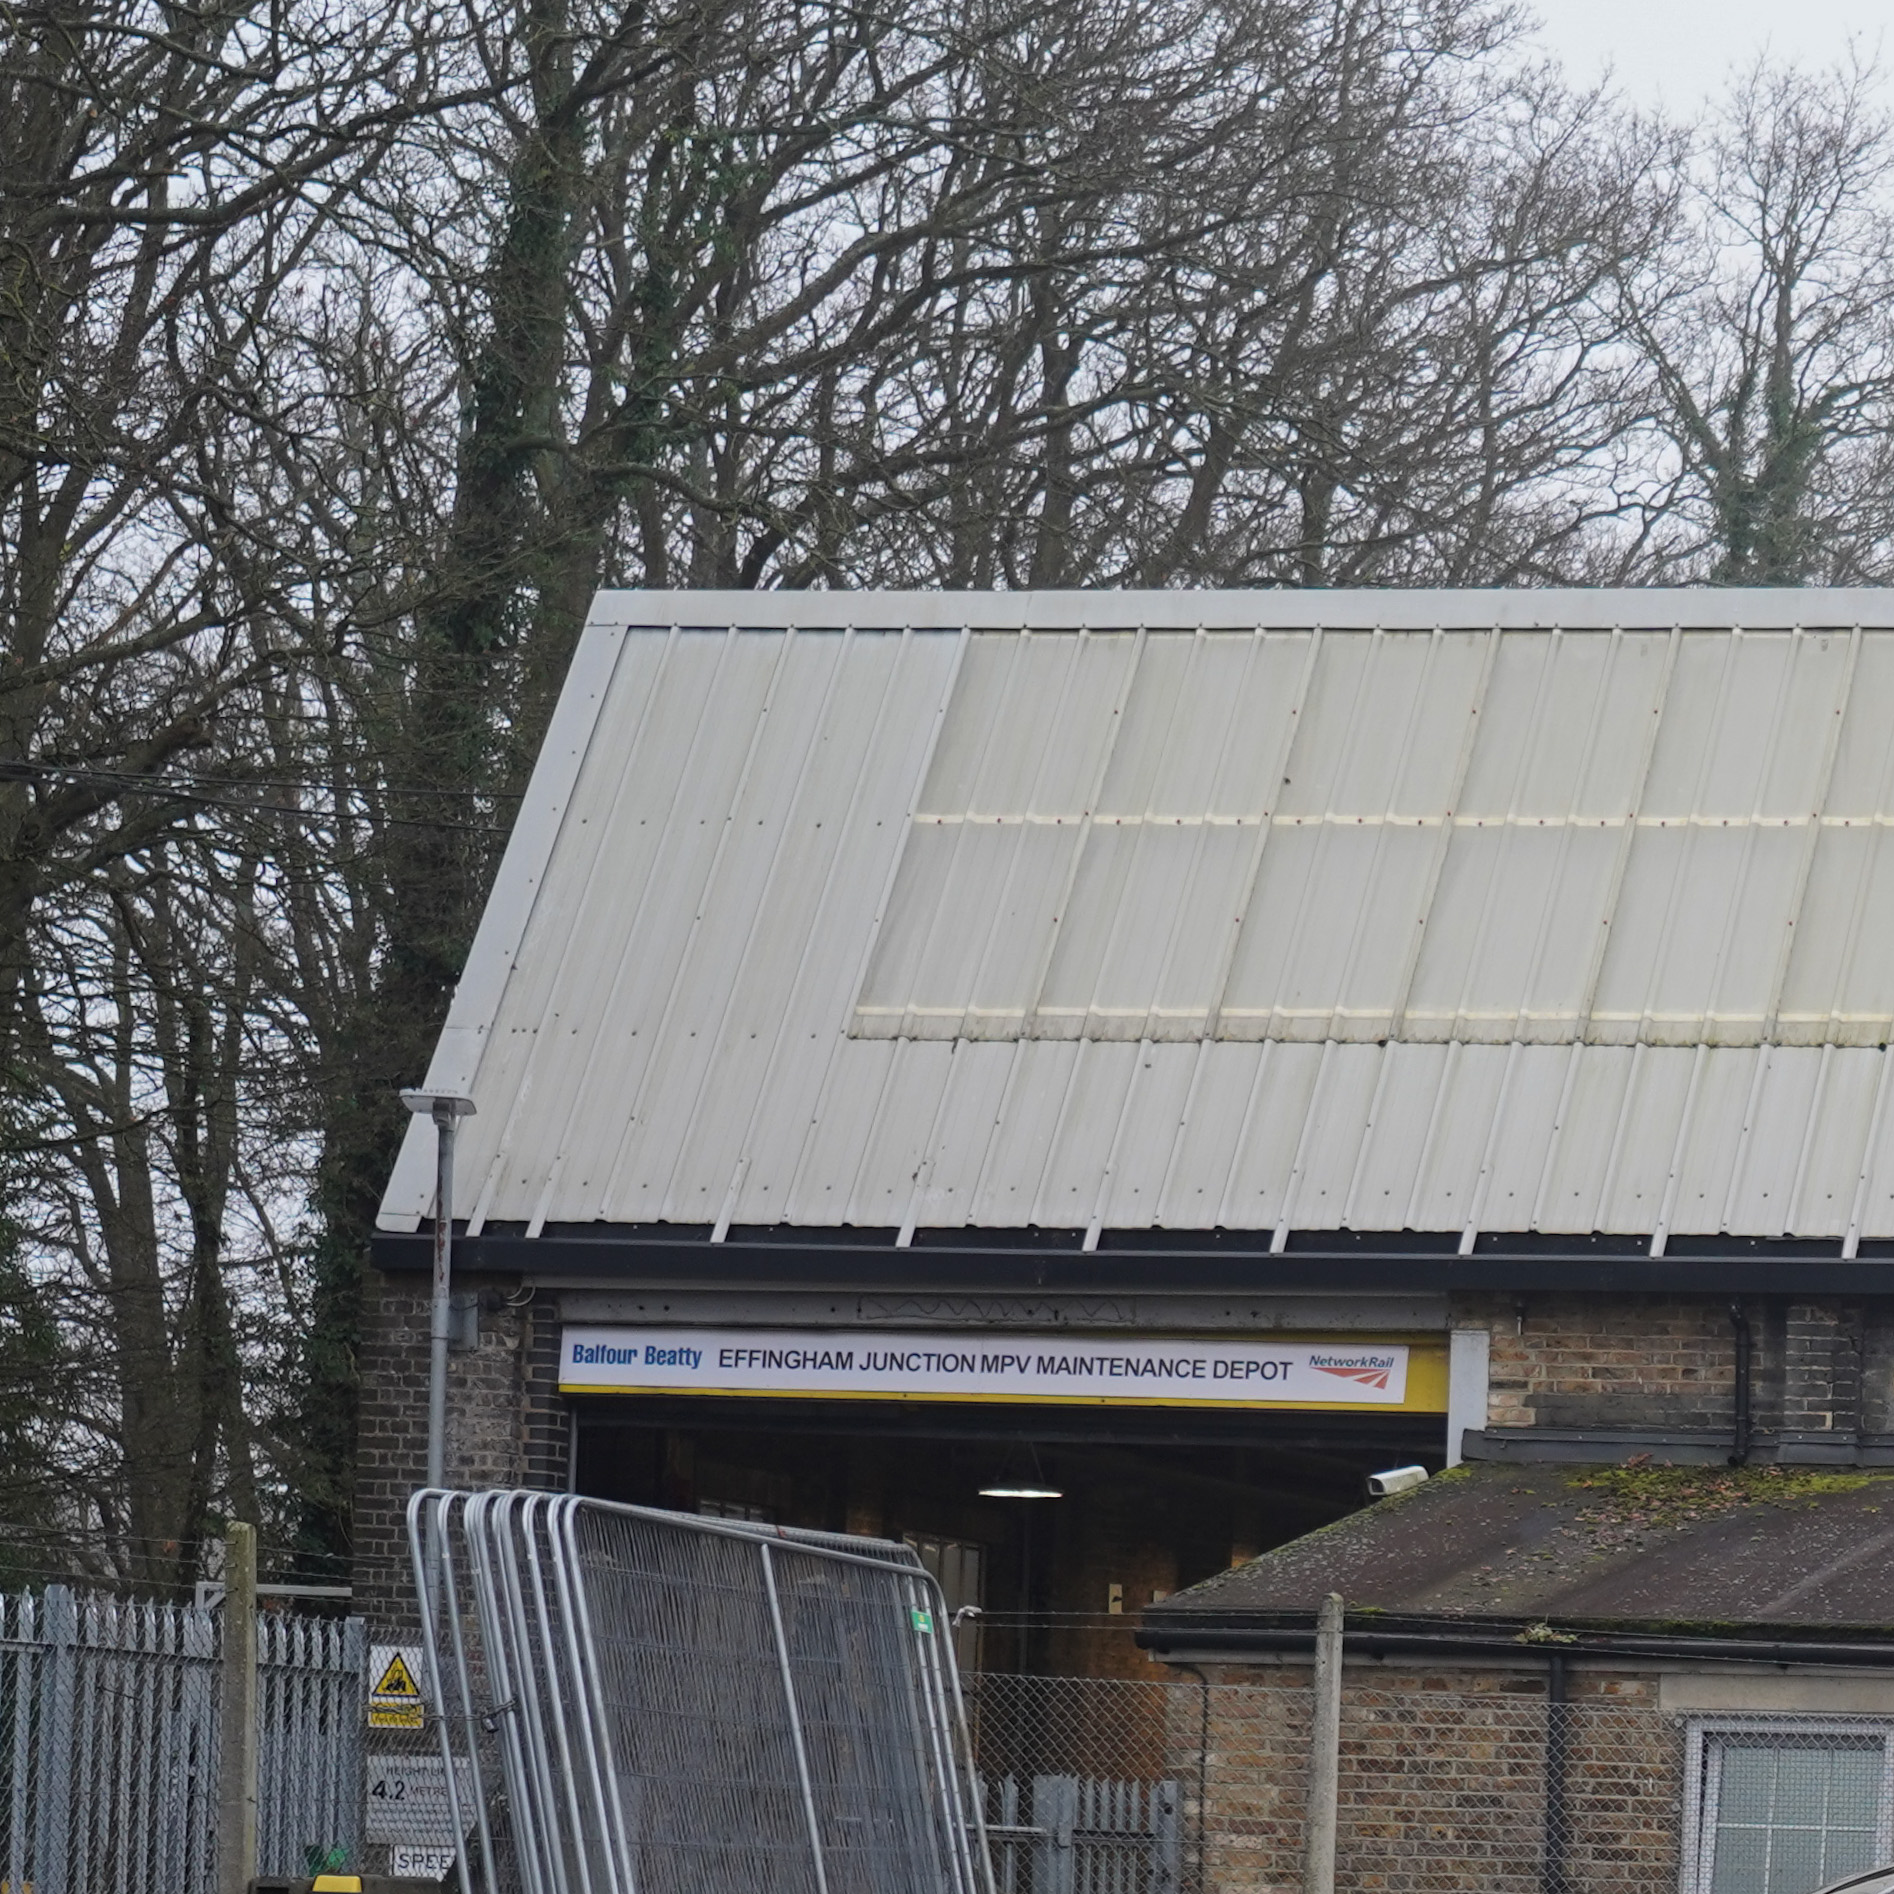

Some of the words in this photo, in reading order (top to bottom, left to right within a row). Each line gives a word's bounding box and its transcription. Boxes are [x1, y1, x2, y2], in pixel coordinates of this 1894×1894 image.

[572, 1344, 638, 1366] Balfour
[644, 1345, 702, 1369] Beatty
[718, 1349, 853, 1371] EFFINGHAM
[859, 1352, 976, 1374] JUNCTION
[980, 1354, 1031, 1374] MPV
[1036, 1355, 1207, 1379] MAINTENANCE
[1213, 1360, 1293, 1381] DEPOT
[1309, 1355, 1394, 1368] NetworkRail
[386, 1767, 428, 1777] HEIGHT
[372, 1780, 405, 1800] 4.2
[398, 1854, 457, 1869] SPEE
